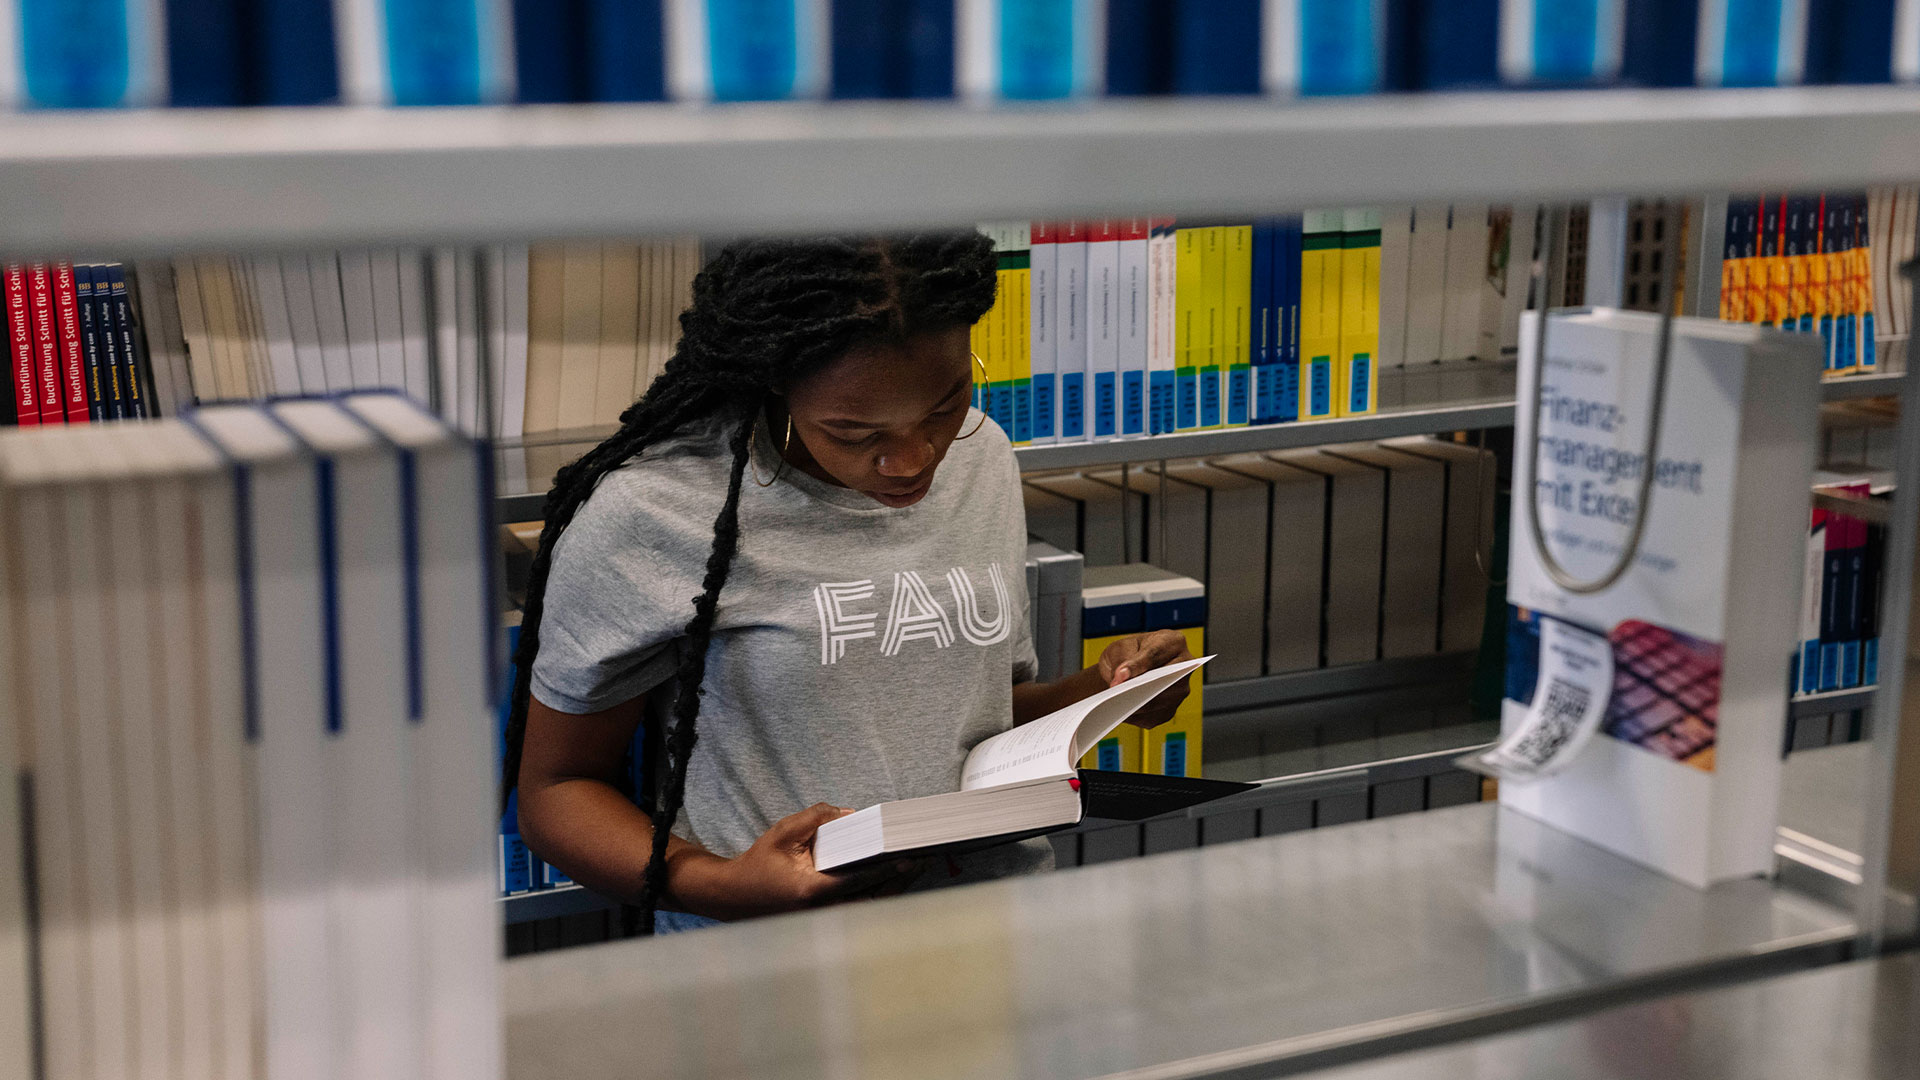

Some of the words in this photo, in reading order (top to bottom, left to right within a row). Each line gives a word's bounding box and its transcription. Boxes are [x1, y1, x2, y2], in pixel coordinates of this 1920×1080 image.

[9, 263, 21, 291] Schrit
[33, 262, 45, 290] Schrit
[57, 260, 70, 289] Schrit
[12, 294, 22, 308] für
[36, 292, 46, 307] für
[62, 291, 72, 305] für
[14, 310, 26, 342] Schritt
[38, 309, 50, 340] Schritt
[63, 307, 75, 339] Schritt
[19, 344, 32, 405] Buchführung
[43, 343, 56, 404] Buchführung
[69, 341, 83, 402] Buchführung
[1580, 479, 1638, 527] Exce
[814, 563, 1011, 664] FAU
